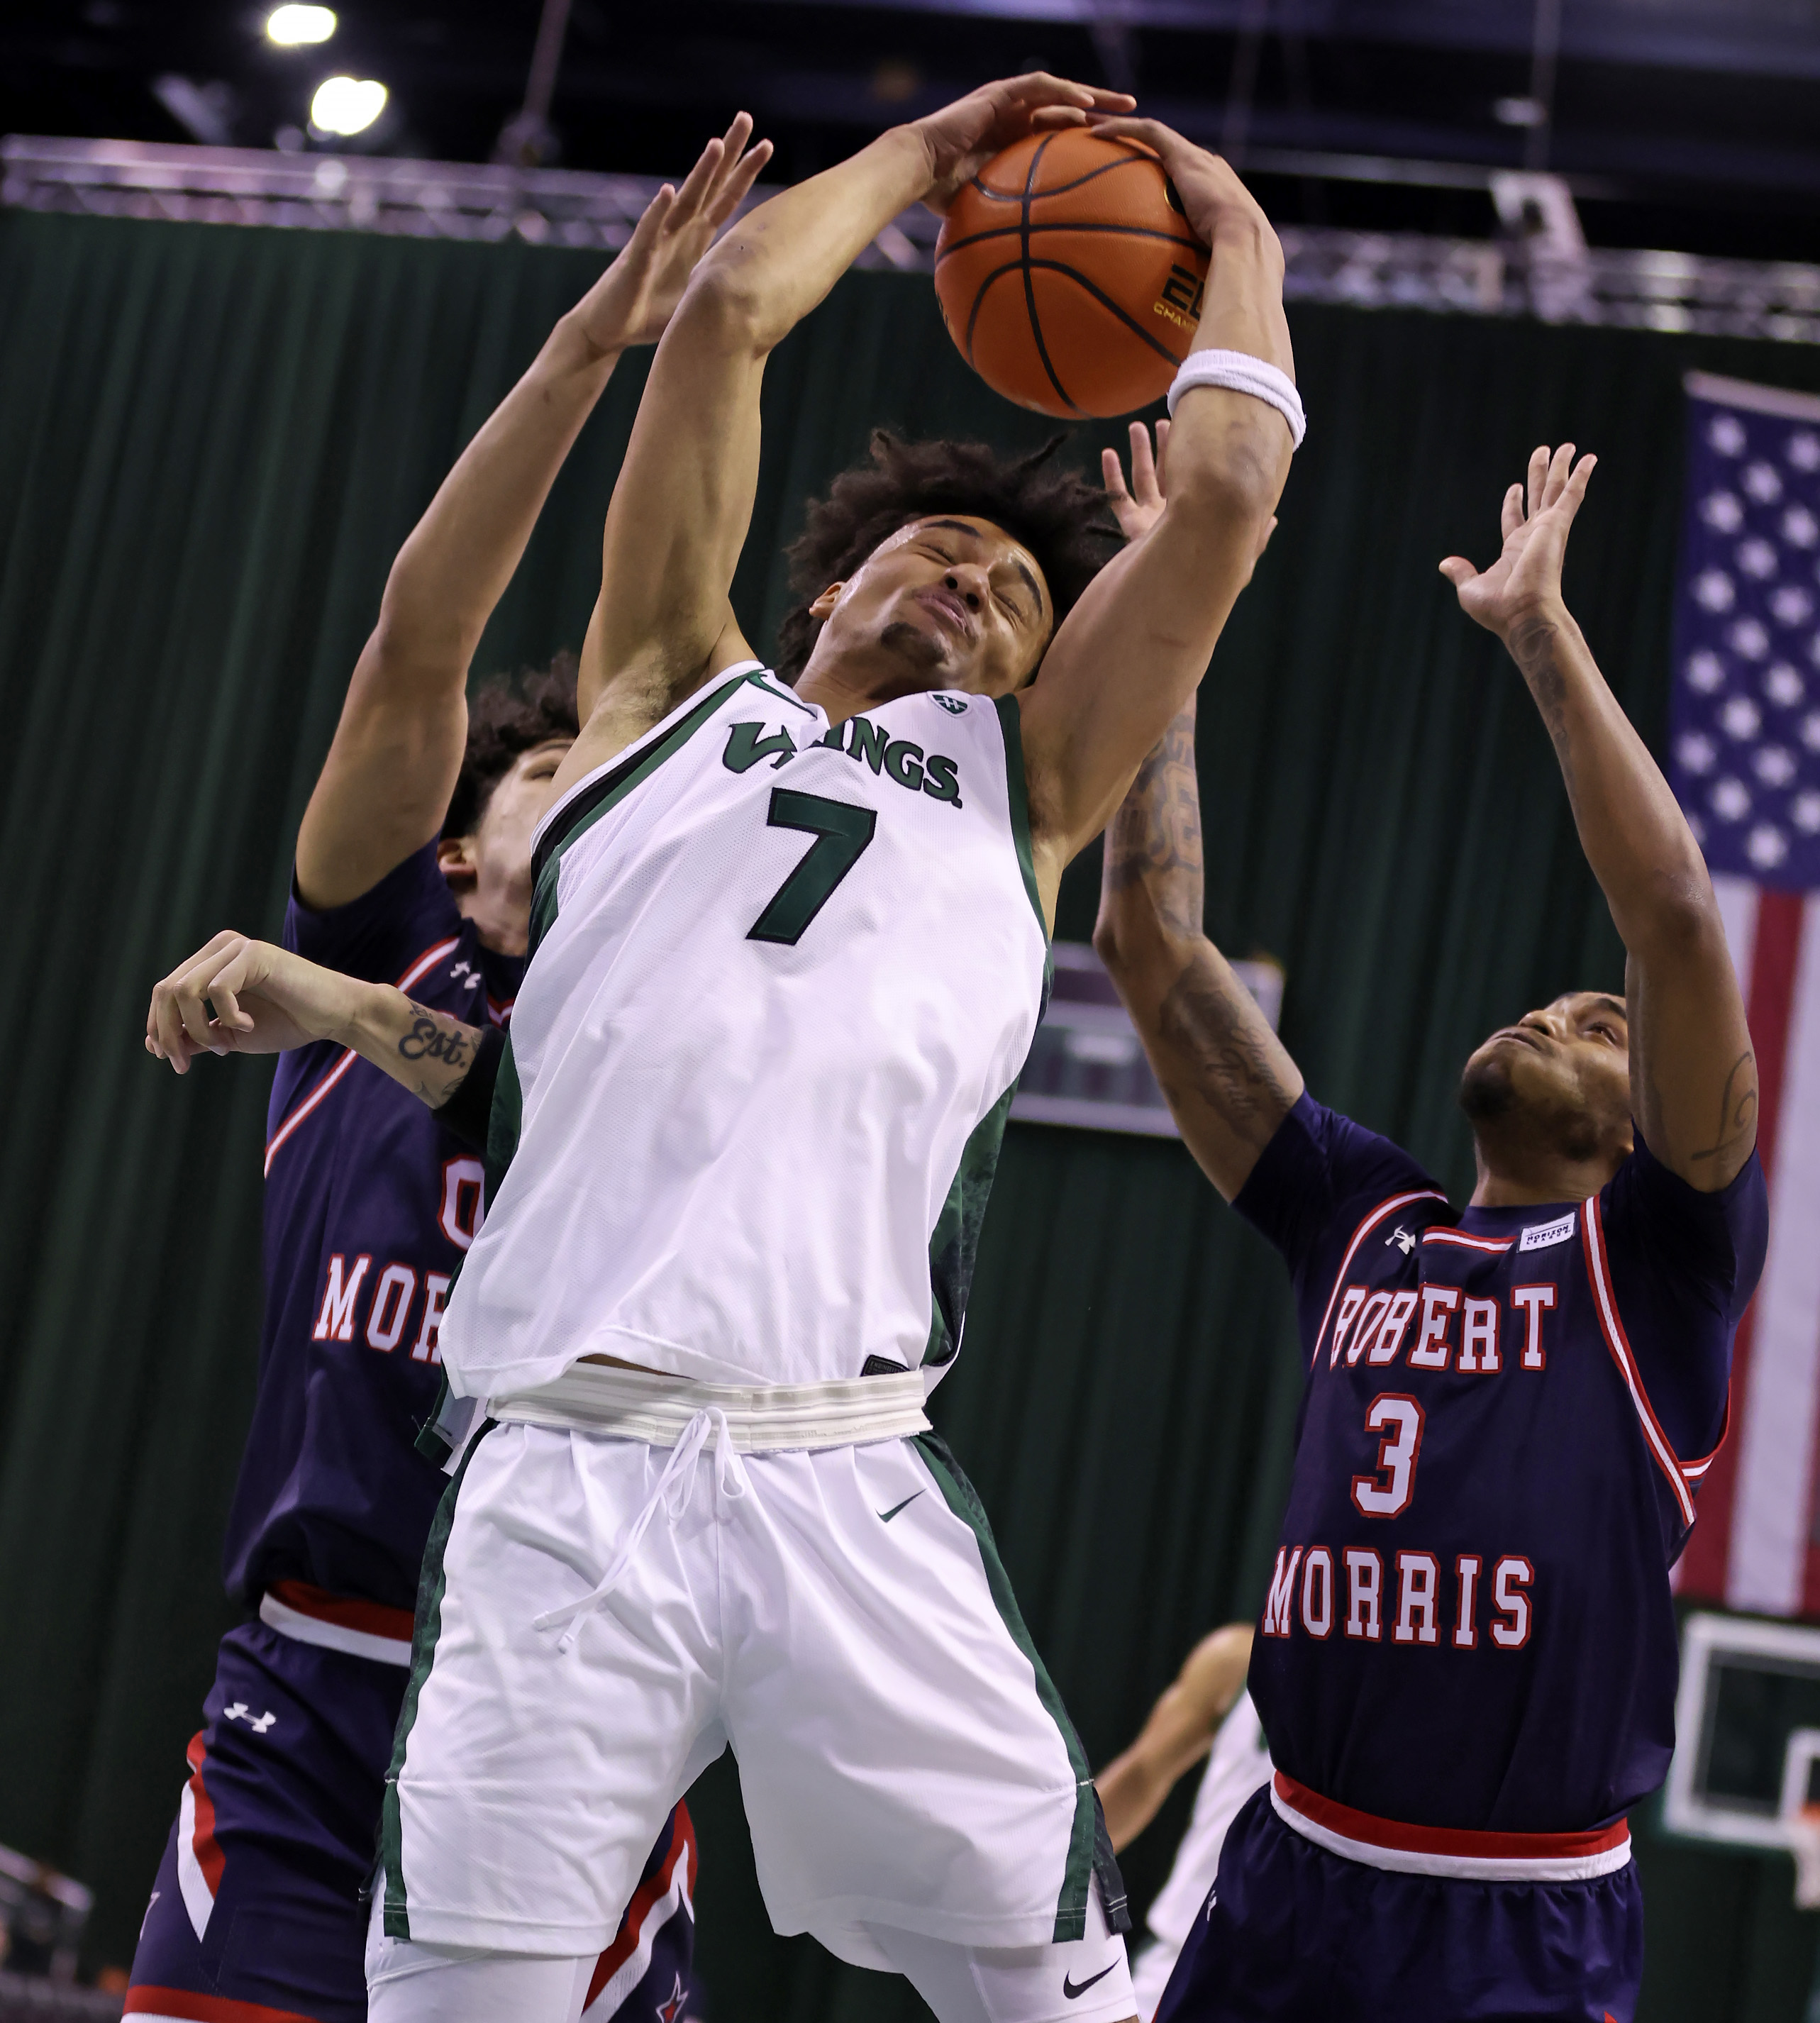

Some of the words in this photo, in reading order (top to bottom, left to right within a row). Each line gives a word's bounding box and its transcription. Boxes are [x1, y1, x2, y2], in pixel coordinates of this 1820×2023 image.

[722, 716, 962, 809] VINGS
[745, 787, 877, 946] 7
[399, 1018, 468, 1068] Est.
[1527, 1224, 1569, 1242] HORIZON
[1330, 1283, 1558, 1374] ROBERT
[1350, 1392, 1426, 1519] 3
[1262, 1546, 1534, 1651] MORRIS
